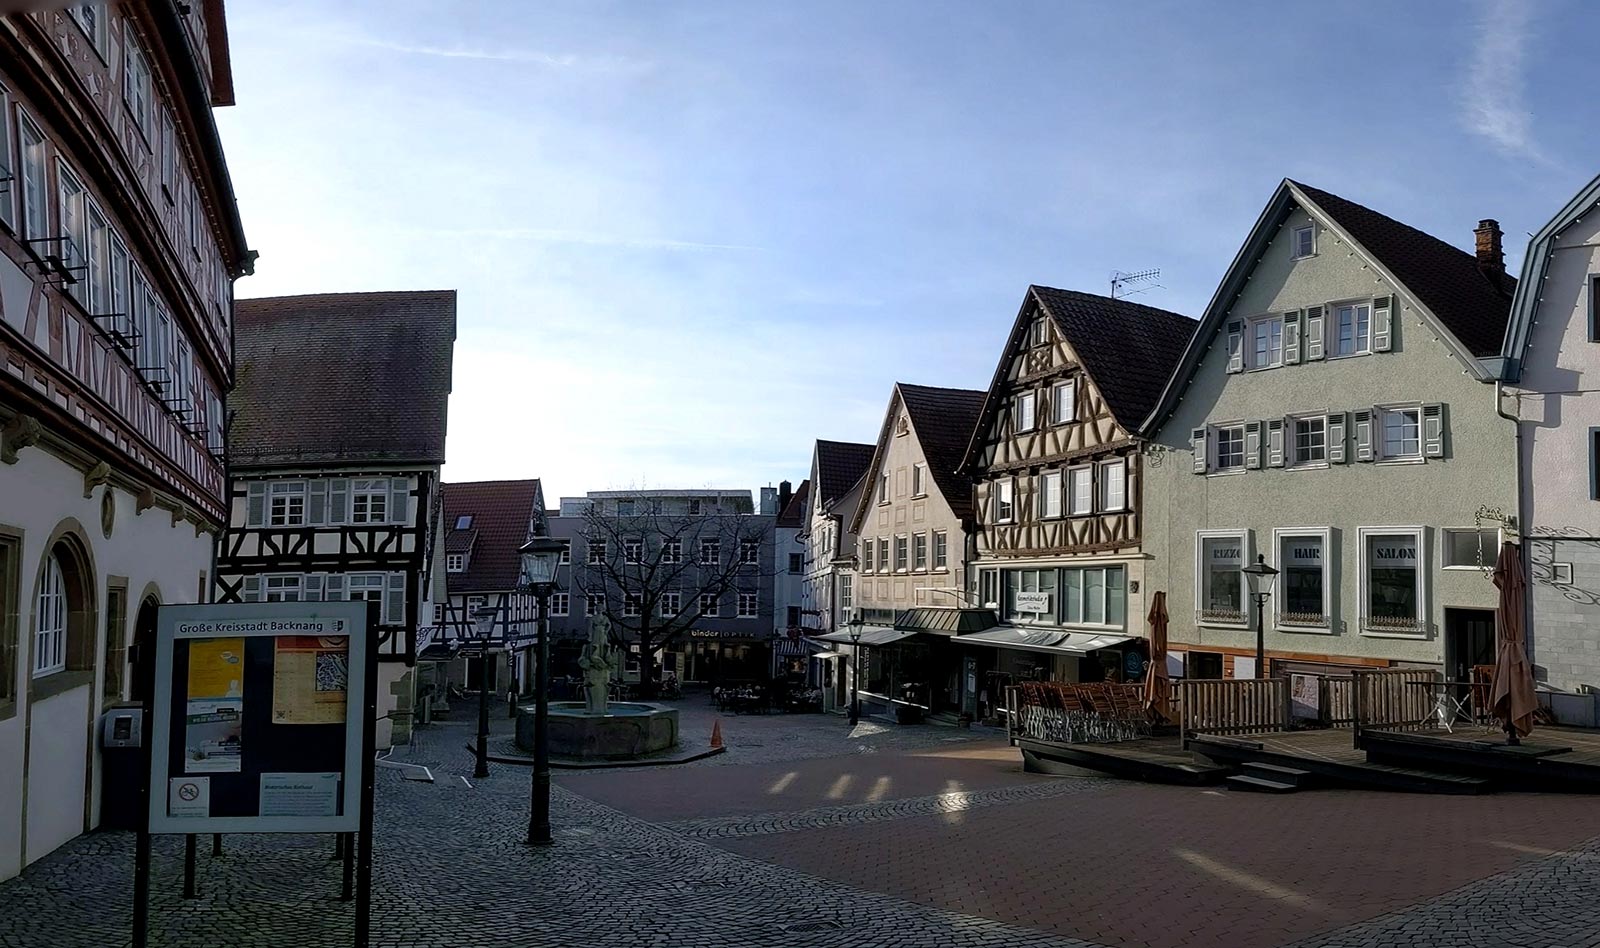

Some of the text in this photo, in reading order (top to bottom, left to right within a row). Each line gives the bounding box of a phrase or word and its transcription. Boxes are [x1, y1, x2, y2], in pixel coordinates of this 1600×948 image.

[1294, 548, 1320, 559] HAIR
[1376, 548, 1416, 559] SALON
[179, 620, 323, 634] Große Kreisstadt Backnang
[691, 629, 719, 637] binder
